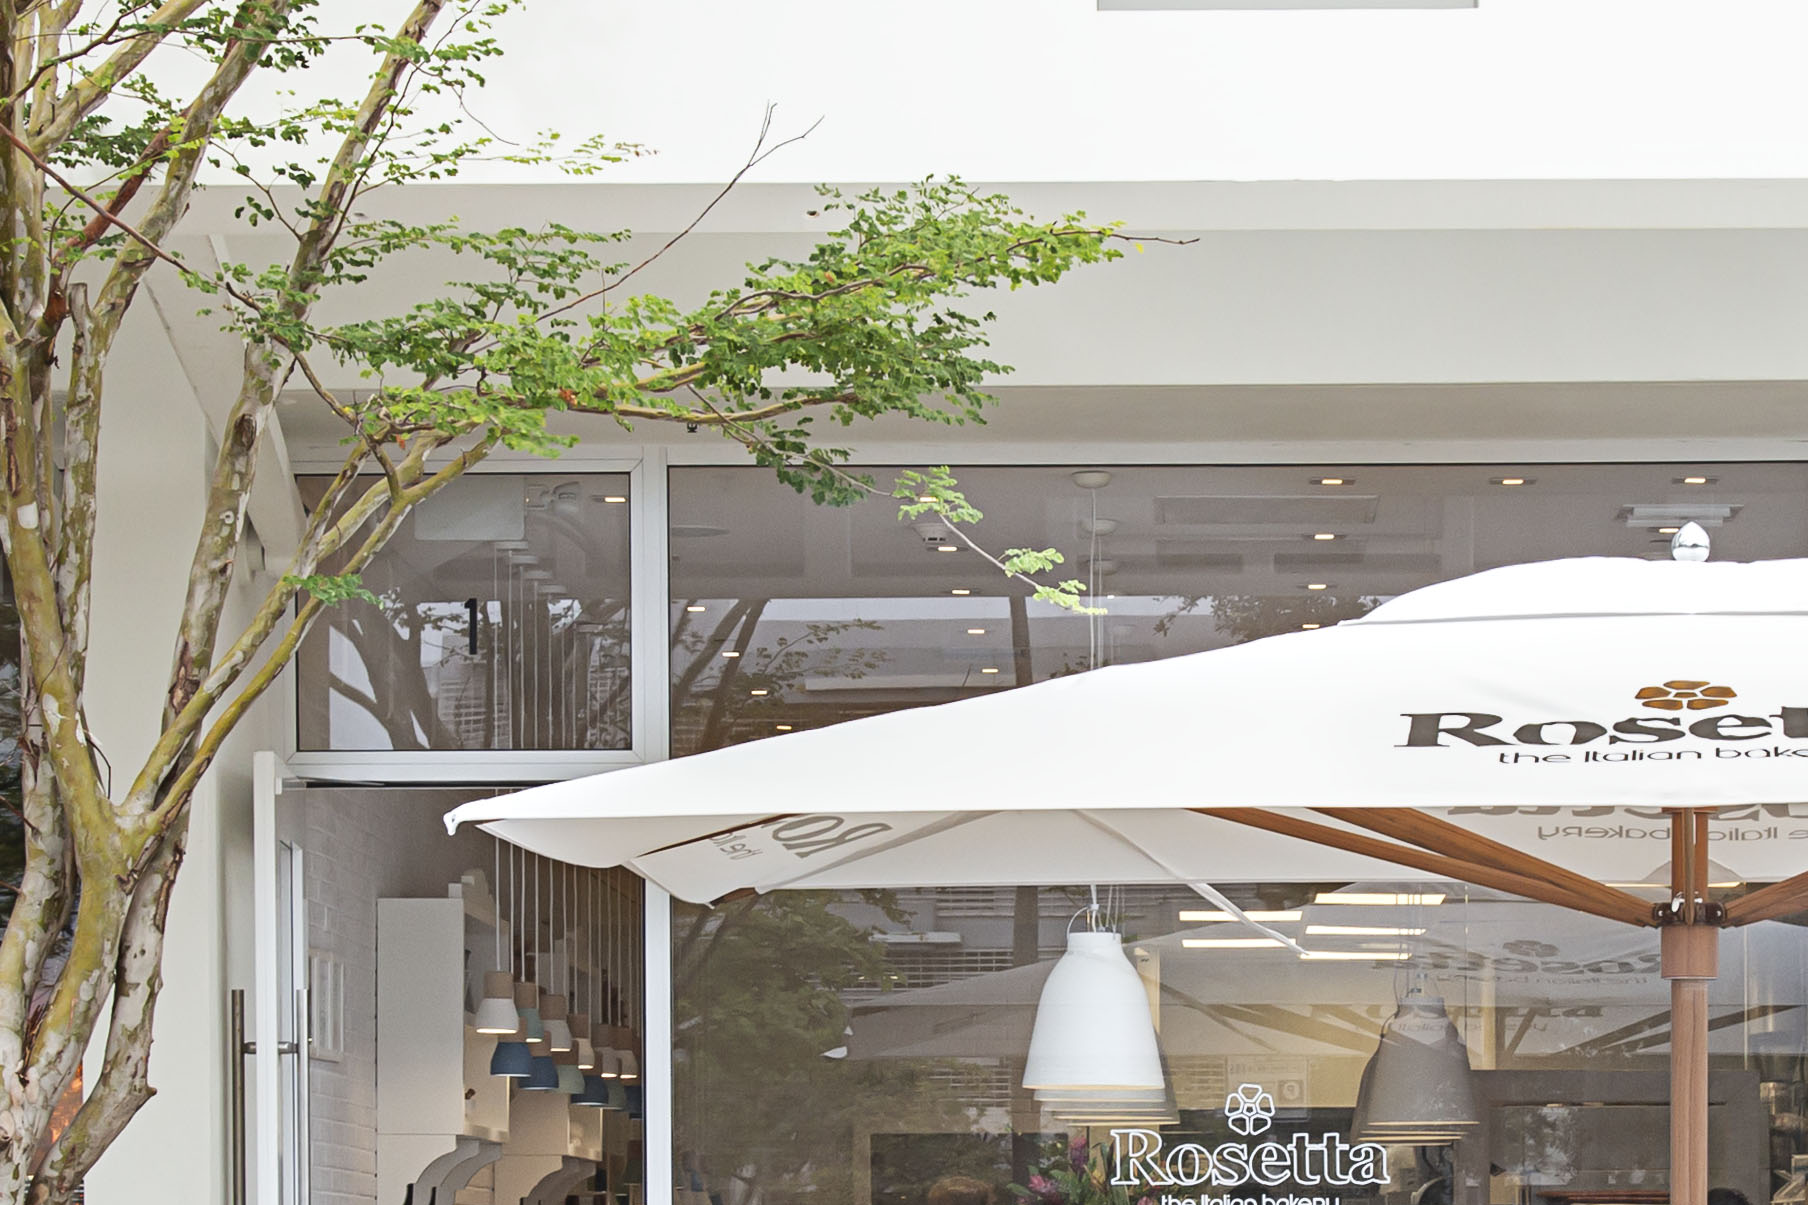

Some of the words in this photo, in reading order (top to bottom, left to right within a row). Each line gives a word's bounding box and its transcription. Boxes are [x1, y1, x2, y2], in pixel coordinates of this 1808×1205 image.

[1499, 751, 1571, 764] the
[1584, 749, 1702, 762] Italian
[1110, 1128, 1391, 1186] Rosetta
